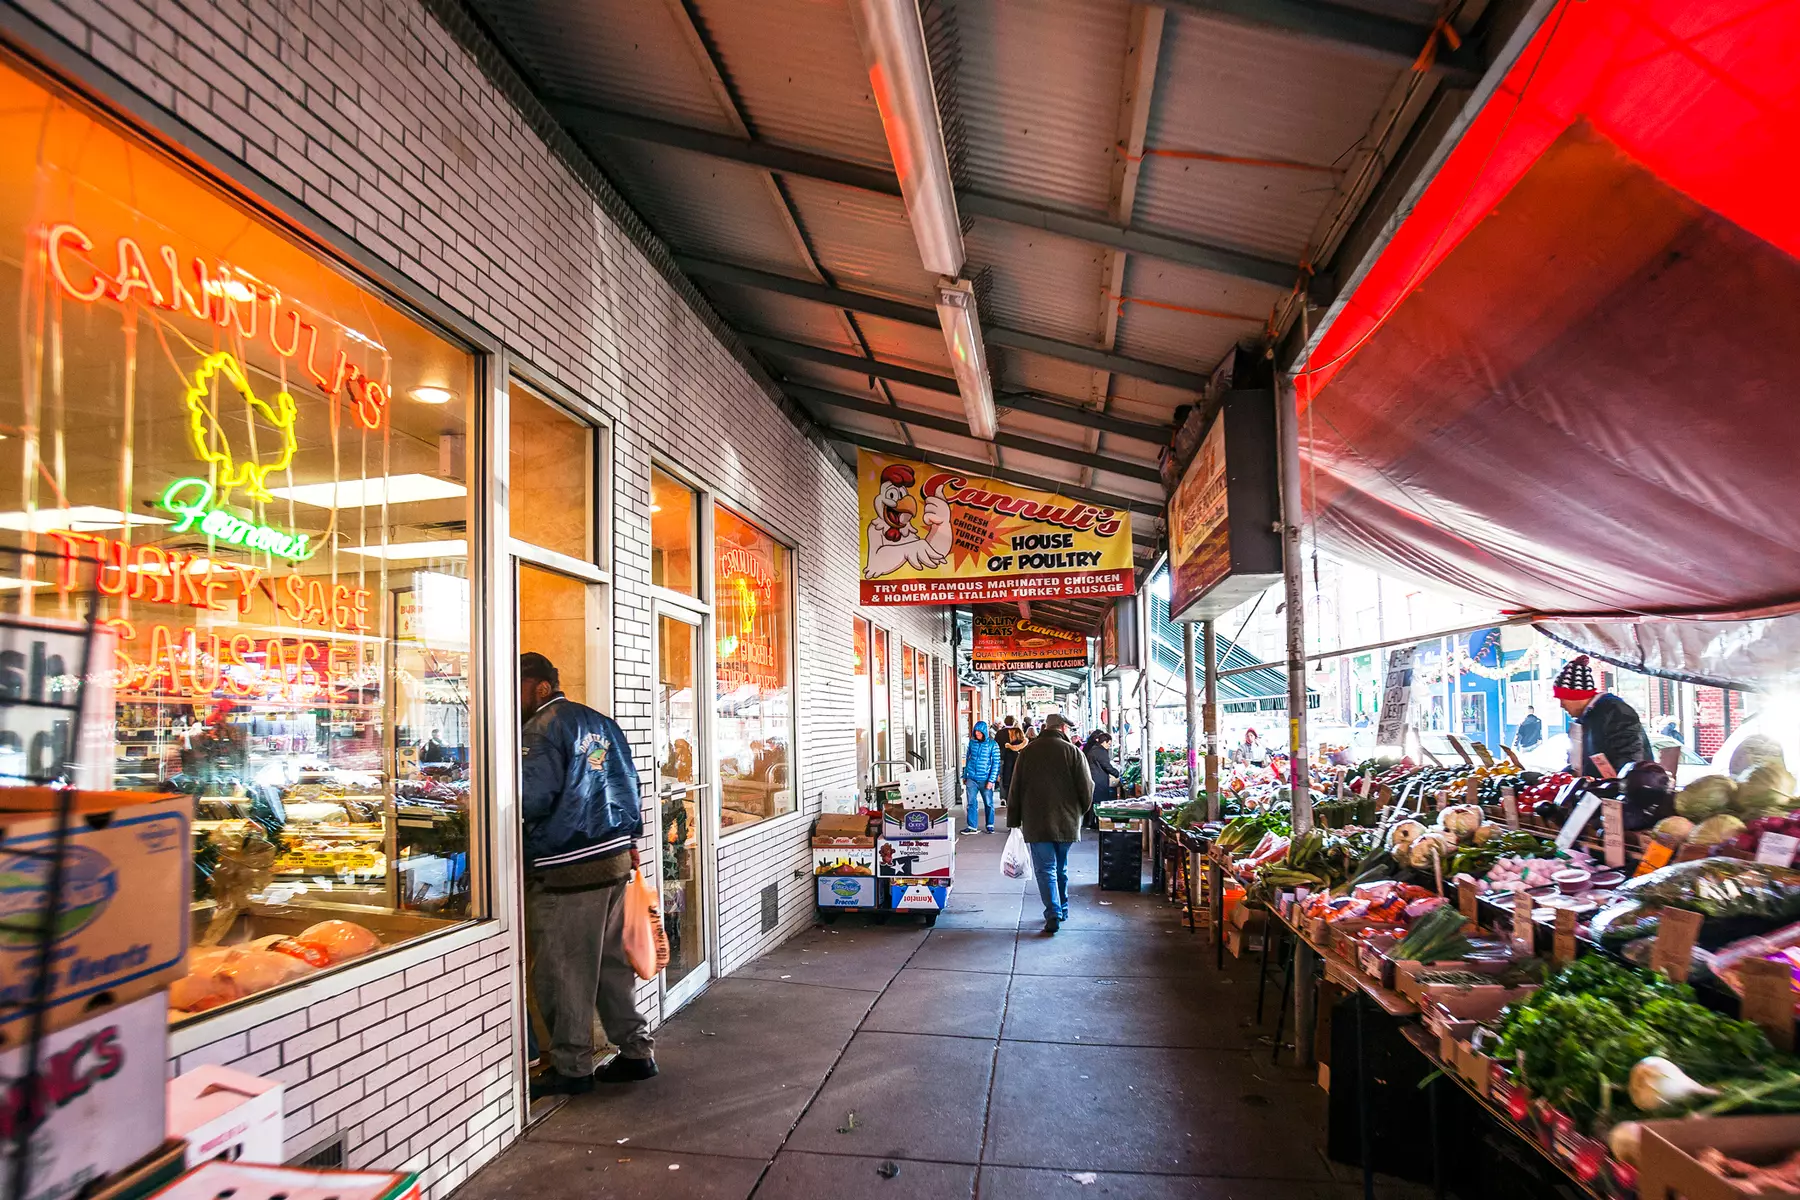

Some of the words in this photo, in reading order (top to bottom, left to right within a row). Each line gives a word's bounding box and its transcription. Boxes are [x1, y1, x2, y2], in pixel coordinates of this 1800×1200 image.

[920, 474, 1121, 537] Cannuli's
[163, 477, 315, 562] Famous
[953, 518, 988, 538] CHICKEN
[989, 532, 994, 540] &
[963, 513, 989, 528] FRESH
[955, 528, 985, 545] TURKEY
[955, 539, 980, 552] PARTS
[1012, 533, 1073, 551] HOUSE
[987, 556, 1013, 572] OF
[1018, 551, 1102, 569] POULTRY
[48, 528, 261, 614] TURKEY
[282, 574, 371, 630] SAGE
[873, 585, 898, 593] TRY
[901, 583, 927, 592] OUR
[931, 581, 983, 591] FAMOUS
[987, 577, 1060, 589] MARINATED
[1064, 574, 1120, 585] CHICKEN
[871, 594, 880, 602] &
[884, 592, 955, 602] HOMEMADE
[959, 588, 1007, 600] ITALIAN
[1011, 588, 1060, 598] TURKEY
[1065, 583, 1124, 595] SAUSAGE
[974, 616, 1017, 626] QUALITY
[1016, 619, 1082, 643] Cannuli's
[980, 627, 1014, 636] MEATS
[105, 618, 351, 701] SAUSAGE
[1011, 649, 1038, 657] MEATS
[1046, 648, 1084, 656] POULTRY
[975, 662, 1006, 670] CANNULI'S
[1007, 661, 1035, 670] CATERING
[1035, 660, 1044, 669] for
[1052, 659, 1085, 668] OCCASIONS
